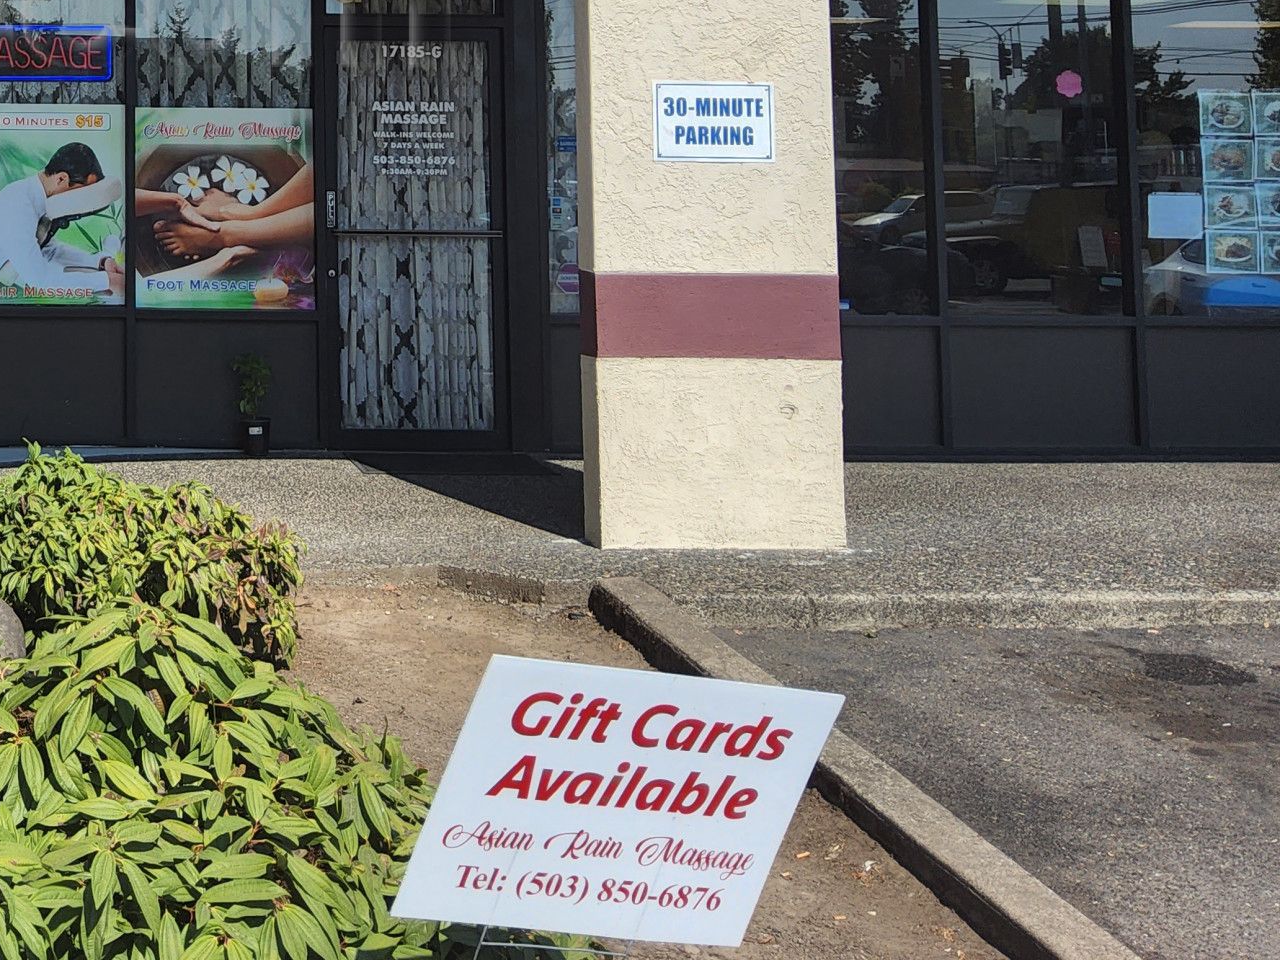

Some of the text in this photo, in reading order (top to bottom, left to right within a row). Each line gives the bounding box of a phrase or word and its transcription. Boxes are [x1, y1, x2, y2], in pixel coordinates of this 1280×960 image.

[381, 45, 442, 59] 17185-G
[372, 100, 455, 113] ASIAN RAIN
[663, 96, 764, 118] 30-MINUTE
[14, 117, 70, 127] MINUTES
[74, 114, 105, 129] $15
[380, 113, 447, 125] MASSAGE
[143, 121, 304, 143] Asian Rain Massage
[372, 131, 455, 139] WALK-INS WELCOME
[674, 125, 754, 146] PARKING
[422, 142, 445, 150] WEEK
[372, 155, 456, 165] 503-850-6876
[24, 284, 94, 298] MASSAGE
[146, 278, 256, 292] FOOT MASSAGE
[510, 691, 794, 761] Gift Cards
[486, 754, 759, 820] Available
[442, 820, 755, 880] Asian Rain Massage
[455, 863, 722, 912] Tel: (503) 850-6876
